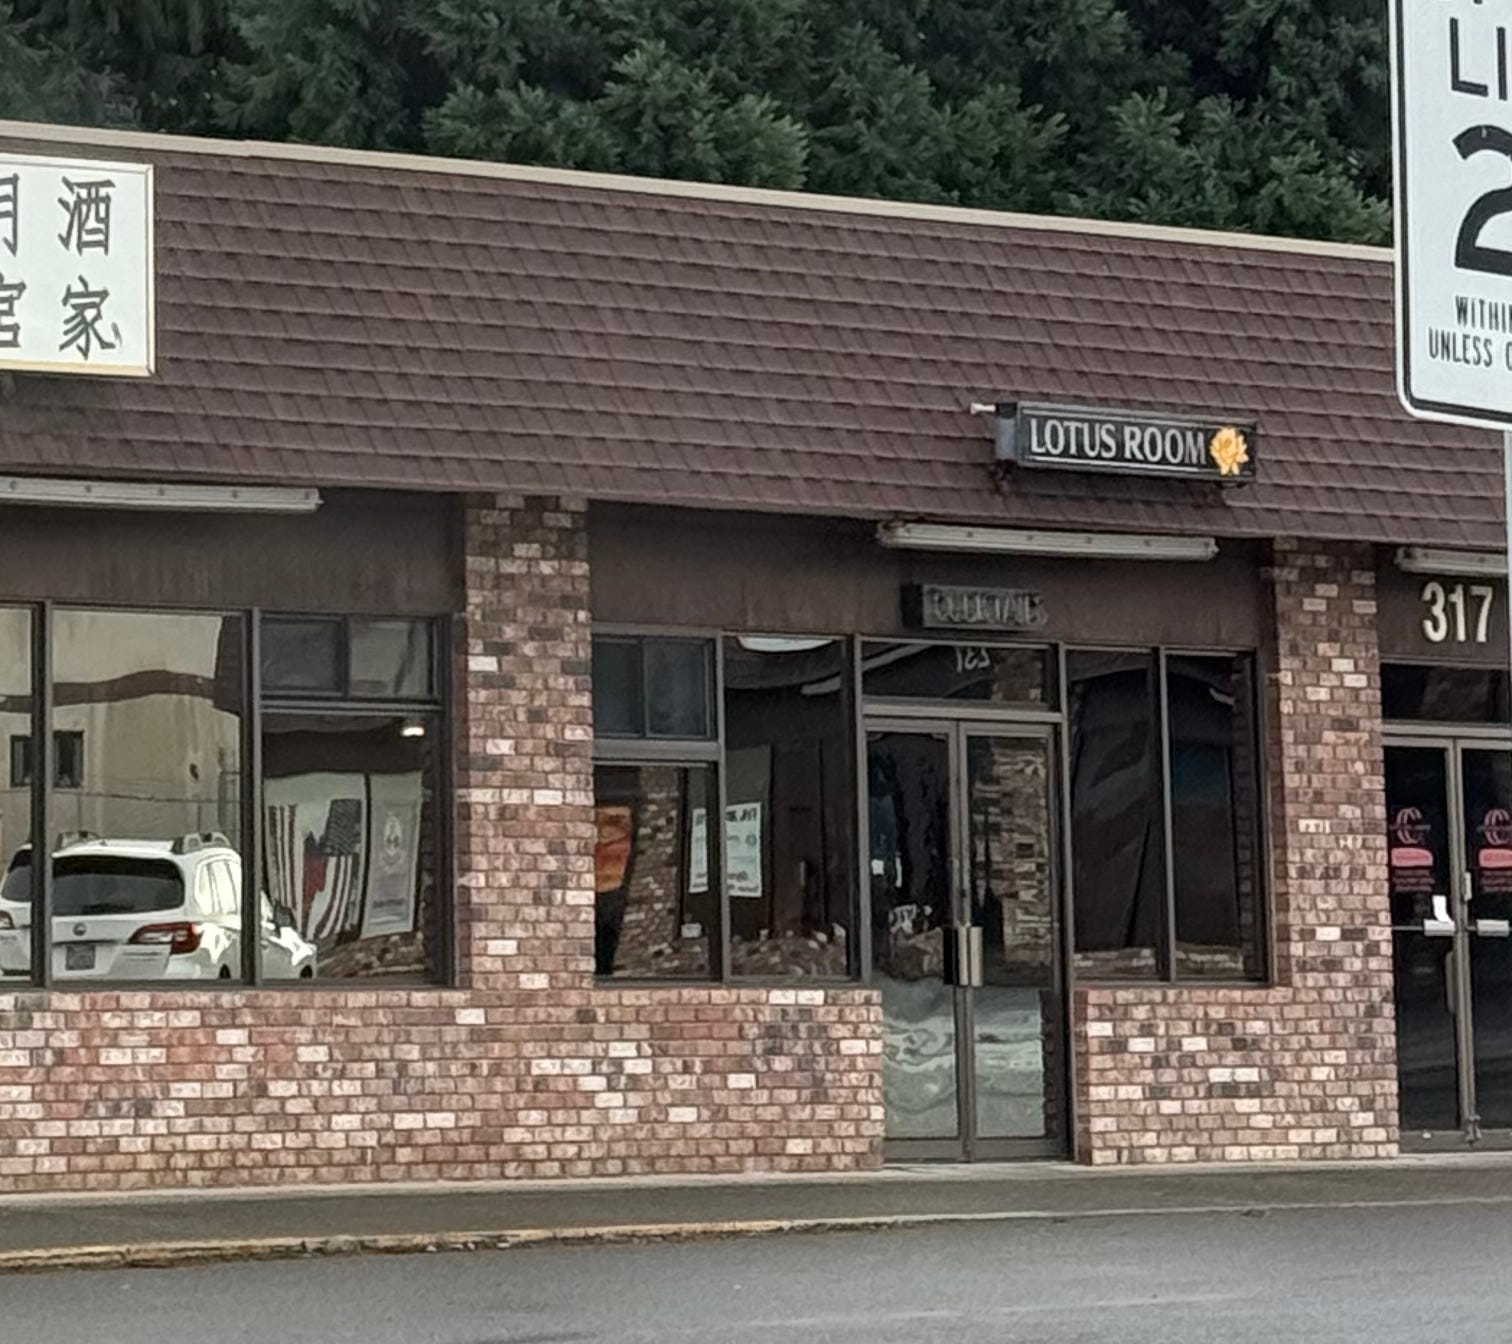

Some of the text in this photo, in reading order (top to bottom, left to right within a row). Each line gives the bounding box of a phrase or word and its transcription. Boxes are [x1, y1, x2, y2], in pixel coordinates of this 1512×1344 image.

[1428, 326, 1493, 368] UNLESS
[1030, 418, 1207, 465] LOTUS ROOM
[1421, 581, 1493, 643] 317
